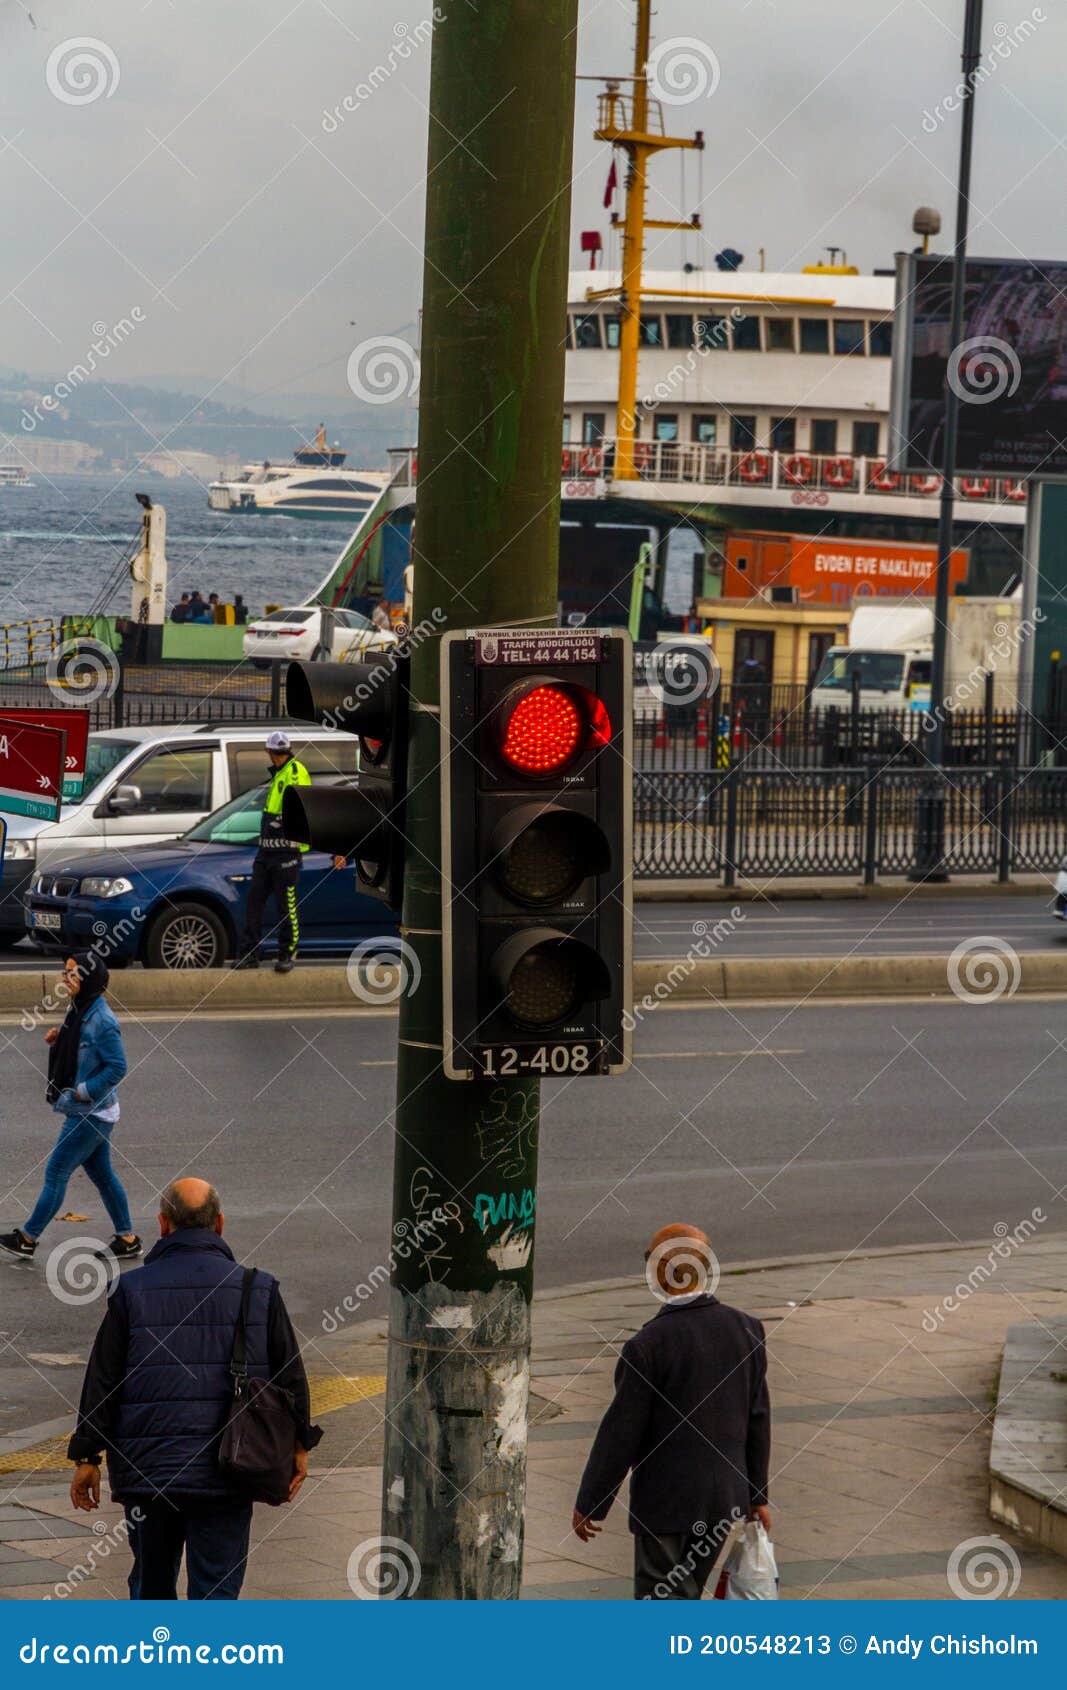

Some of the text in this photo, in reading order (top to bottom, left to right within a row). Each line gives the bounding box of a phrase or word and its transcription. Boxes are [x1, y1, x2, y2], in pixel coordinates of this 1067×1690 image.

[815, 554, 852, 573] EVDEN
[855, 556, 878, 575] EVE
[503, 637, 595, 649] TRAFİK MÜDÜRLÜĞÜ
[502, 648, 597, 662] TEL: 44 44 154
[482, 1045, 590, 1075] 12-408
